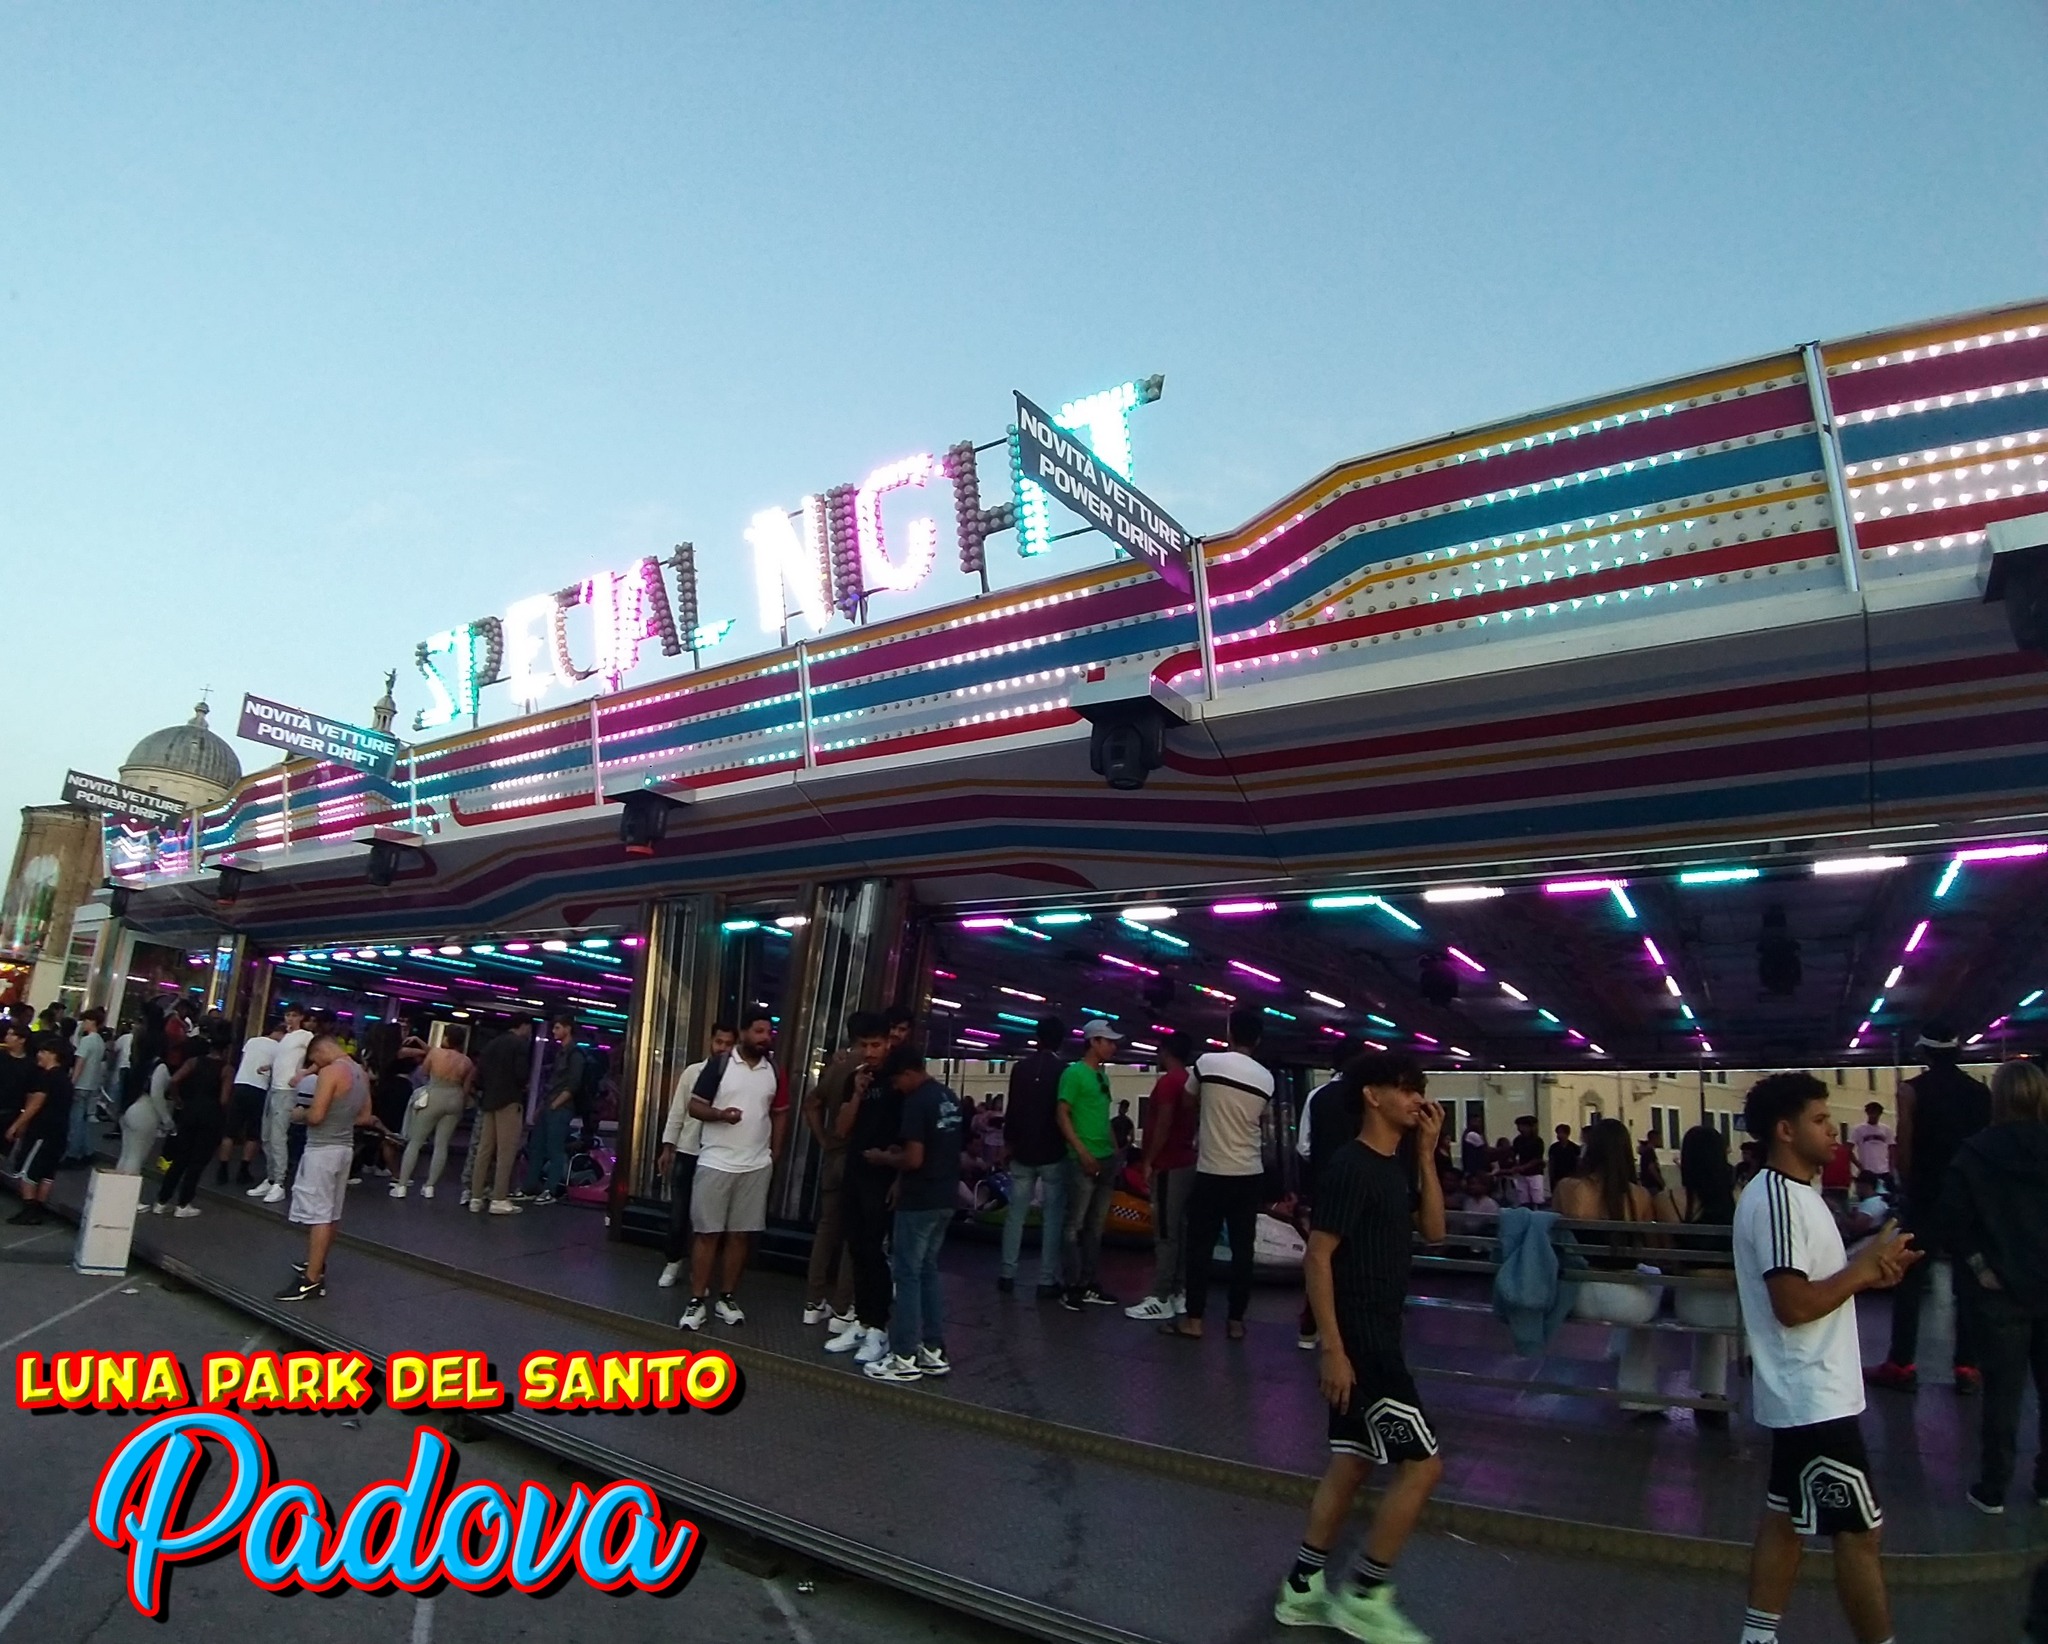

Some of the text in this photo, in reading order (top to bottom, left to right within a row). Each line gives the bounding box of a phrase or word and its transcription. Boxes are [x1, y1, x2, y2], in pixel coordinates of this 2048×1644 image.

[1020, 406, 1182, 553] NOVITÀ VETTURE
[1039, 453, 1169, 567] POWER DRIFT
[412, 373, 1166, 732] SPECIAL NIGHT
[245, 700, 395, 756] NOVITÀ VETTURE
[257, 722, 379, 767] POWER DRIFT
[67, 774, 184, 814] NOVITÀ VETTURE
[76, 789, 170, 822] POWER DRIFT
